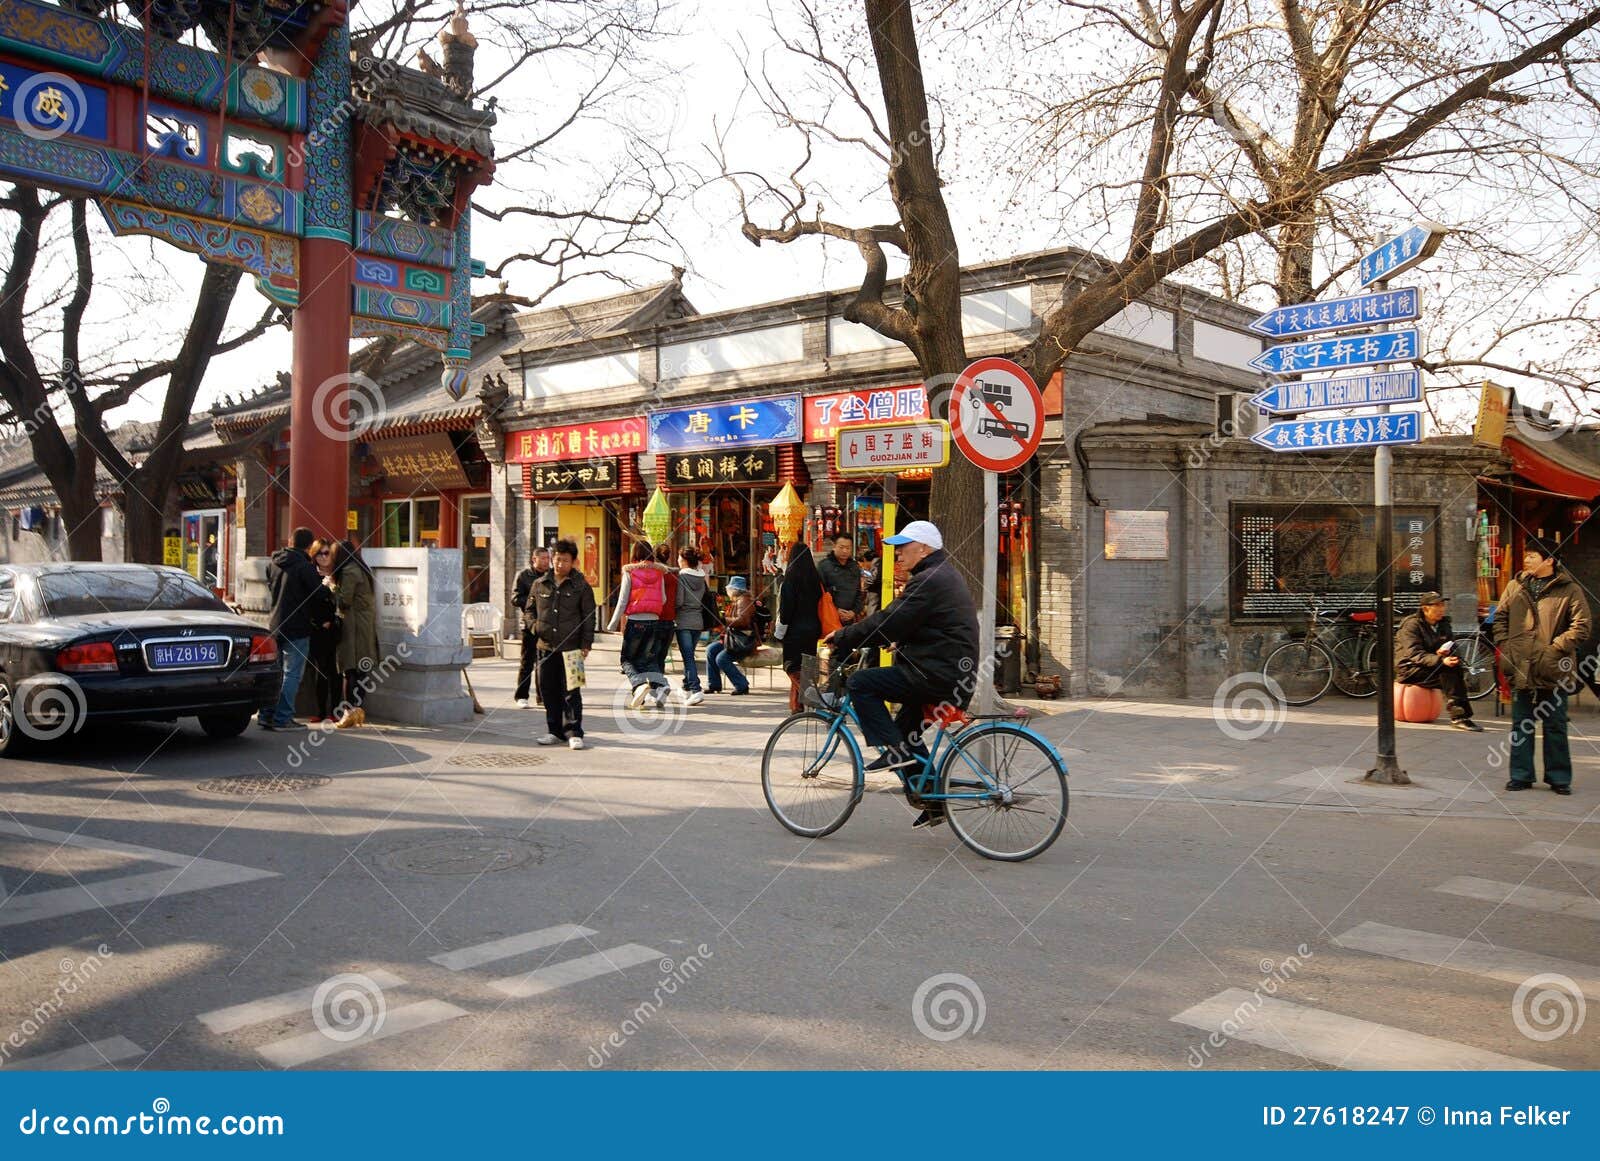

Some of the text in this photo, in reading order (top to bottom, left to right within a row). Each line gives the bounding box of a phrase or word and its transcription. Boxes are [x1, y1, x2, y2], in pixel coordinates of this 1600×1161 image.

[1275, 293, 1412, 334] 中交水运规划设计院
[1326, 379, 1367, 405] VEGETARIAN
[1368, 374, 1414, 402] RESTAURANT
[684, 406, 759, 433] 唐卡
[815, 388, 925, 424] 了尘僧服
[866, 431, 932, 451] 国子监街
[870, 451, 928, 462] GUOZIJIAN JIE
